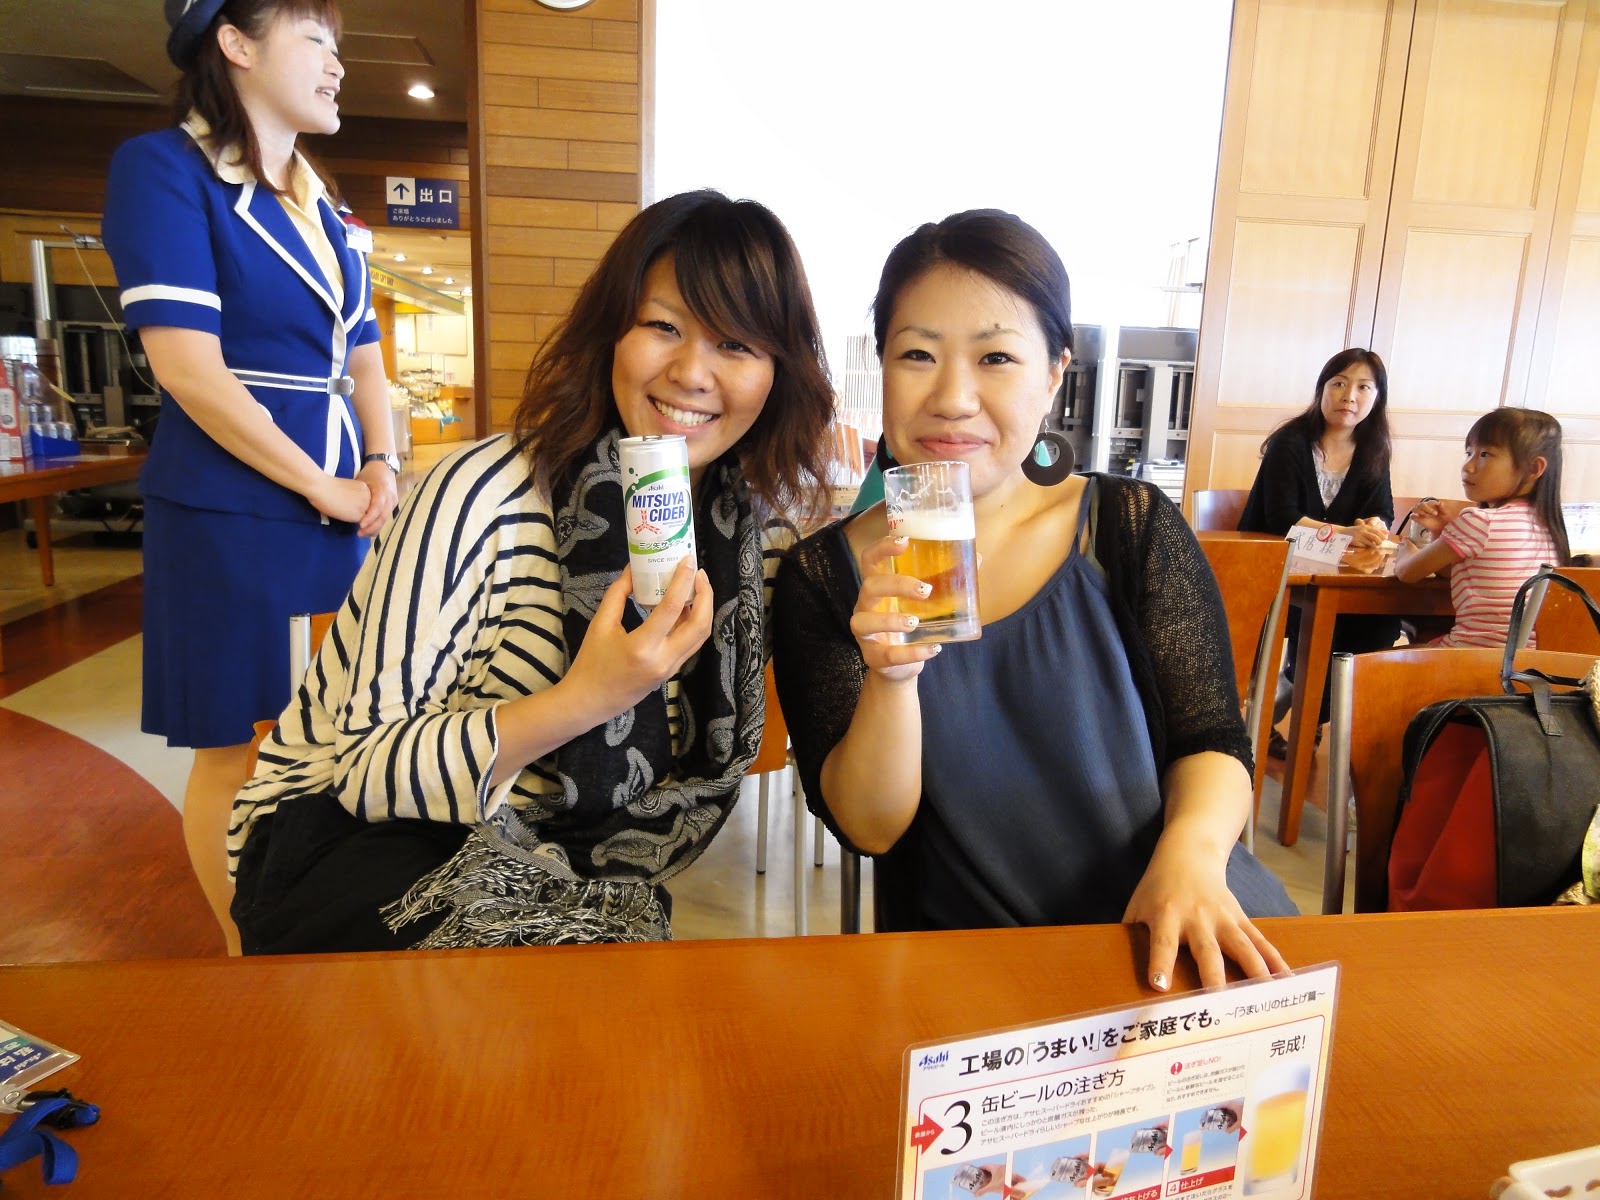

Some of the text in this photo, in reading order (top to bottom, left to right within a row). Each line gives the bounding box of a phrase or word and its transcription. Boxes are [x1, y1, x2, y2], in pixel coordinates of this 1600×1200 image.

[419, 188, 452, 204] 出口
[392, 215, 453, 225] ありがとうございました
[632, 491, 685, 508] MITSUYA
[649, 505, 685, 522] CIDER
[639, 540, 685, 550] 三ツ矢サイダー
[918, 1050, 949, 1067] Asahi
[940, 1069, 1126, 1156] 3 缶ビールの注ぎ方
[1169, 1177, 1204, 1193] 4 仕上げ
